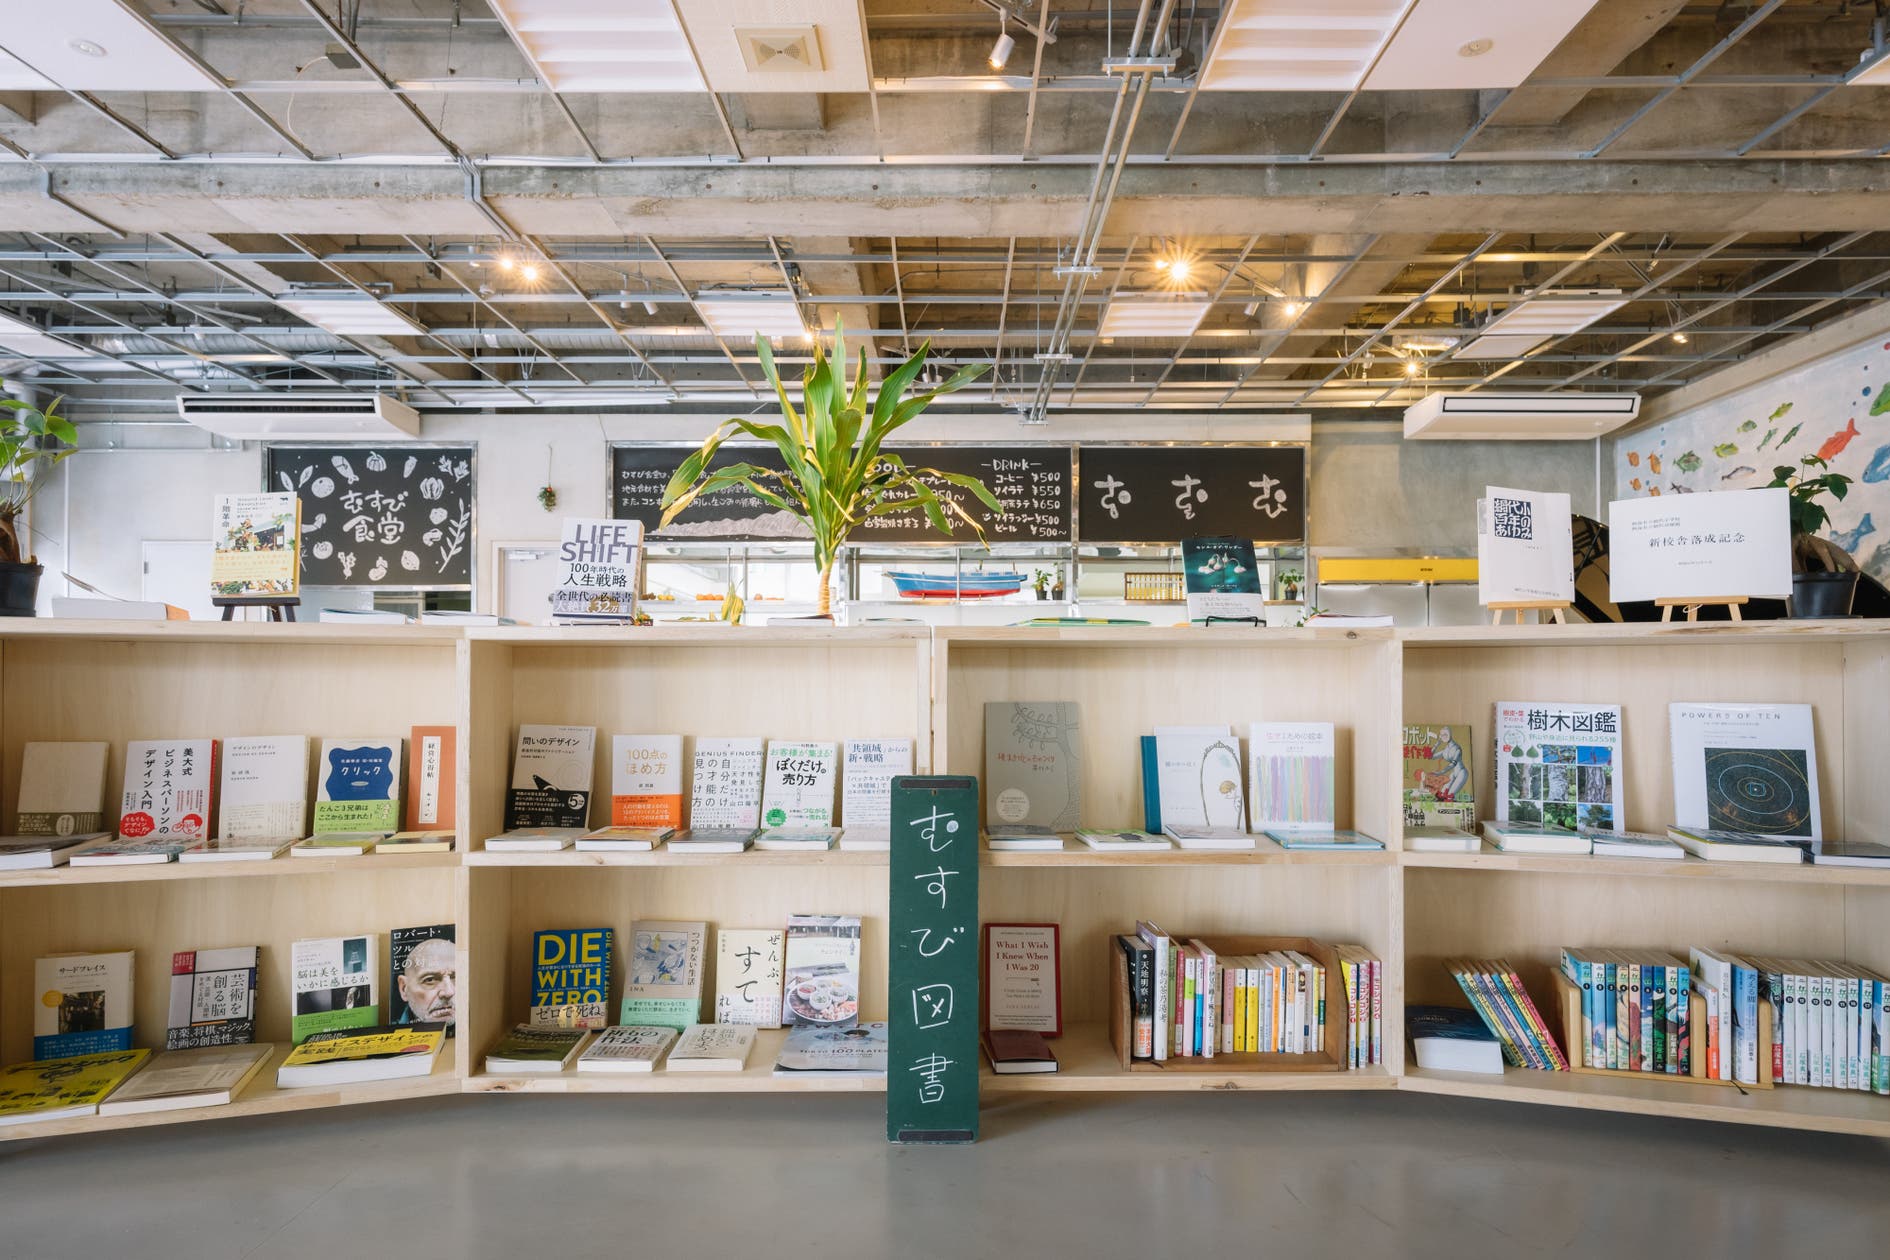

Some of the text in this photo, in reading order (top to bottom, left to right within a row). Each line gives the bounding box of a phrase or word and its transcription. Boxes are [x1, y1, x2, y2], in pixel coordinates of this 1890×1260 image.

[993, 459, 1030, 471] DRINK
[1031, 472, 1061, 482] ¥500
[1031, 485, 1061, 496] ¥550
[339, 489, 408, 514] むすび
[1032, 498, 1061, 510] ¥650
[1034, 513, 1060, 525] ¥500
[342, 511, 405, 545] 食堂
[575, 524, 628, 546] LIFE
[1650, 532, 1745, 548] 新校舎落成記念
[560, 541, 638, 564] SHIFT
[564, 574, 627, 588] 人生戦略
[1527, 709, 1616, 733] 樹木図鑑
[1682, 712, 1730, 720] POWERS
[522, 737, 580, 747] 問いのデザイン
[183, 748, 193, 776] 美大式
[848, 754, 884, 763] 新・戦略
[341, 766, 382, 778] クリック
[626, 763, 668, 775] ほめ方
[141, 749, 157, 810] デザイン入門
[782, 774, 817, 786] 売り方
[159, 749, 176, 834] ビジネスパーソンの
[538, 932, 603, 966] DIE
[996, 941, 1049, 949] What I Wish
[687, 932, 701, 985] つつがない生活
[909, 804, 965, 1104] むすび図書
[1002, 952, 1024, 960] Knew
[1026, 952, 1049, 960] When
[297, 966, 339, 979] 脳は美を
[734, 946, 761, 1003] すて
[1006, 963, 1010, 971] I
[1030, 963, 1040, 971] 20
[297, 975, 369, 990] いかに感じるか
[537, 968, 602, 988] WITH
[211, 975, 228, 1017] 創る脳
[230, 973, 245, 1015] 芸術を
[166, 1033, 233, 1049] 絵画の創造性
